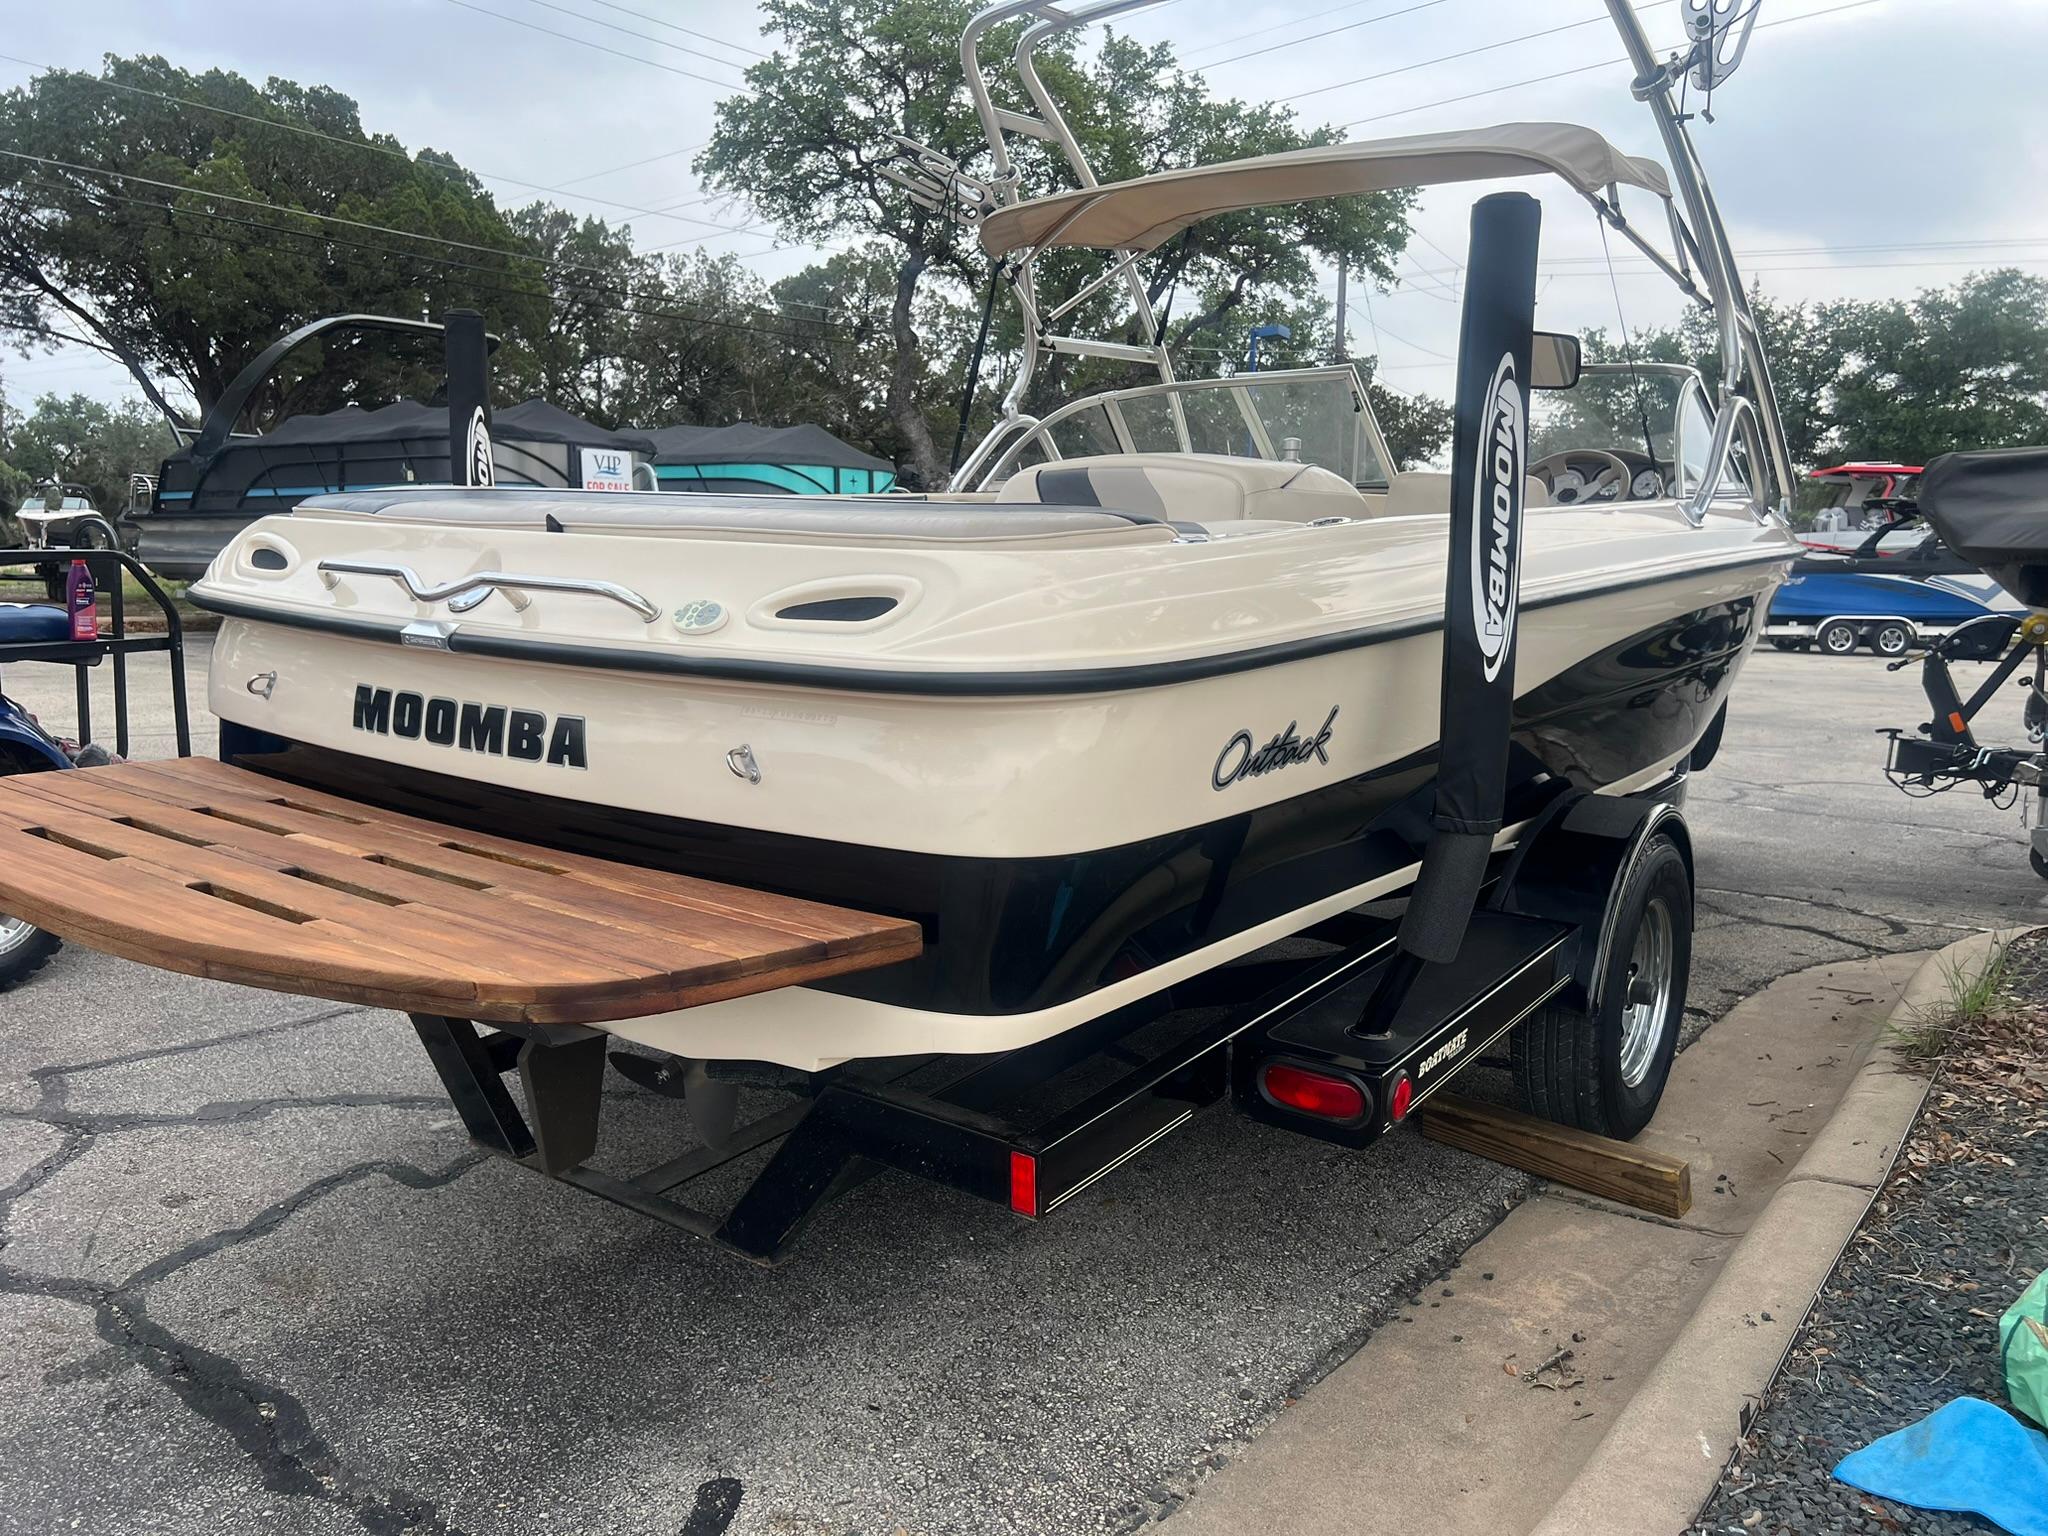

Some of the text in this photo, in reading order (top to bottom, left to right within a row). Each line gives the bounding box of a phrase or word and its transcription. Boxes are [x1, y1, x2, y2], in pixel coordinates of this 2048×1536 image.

[586, 481, 630, 491] FOR SALE
[593, 454, 621, 473] VIP
[1484, 395, 1516, 637] MOOMBA
[352, 682, 588, 771] MOOMBA
[1212, 705, 1340, 791] Outback
[1417, 1027, 1469, 1079] BOATMATE
